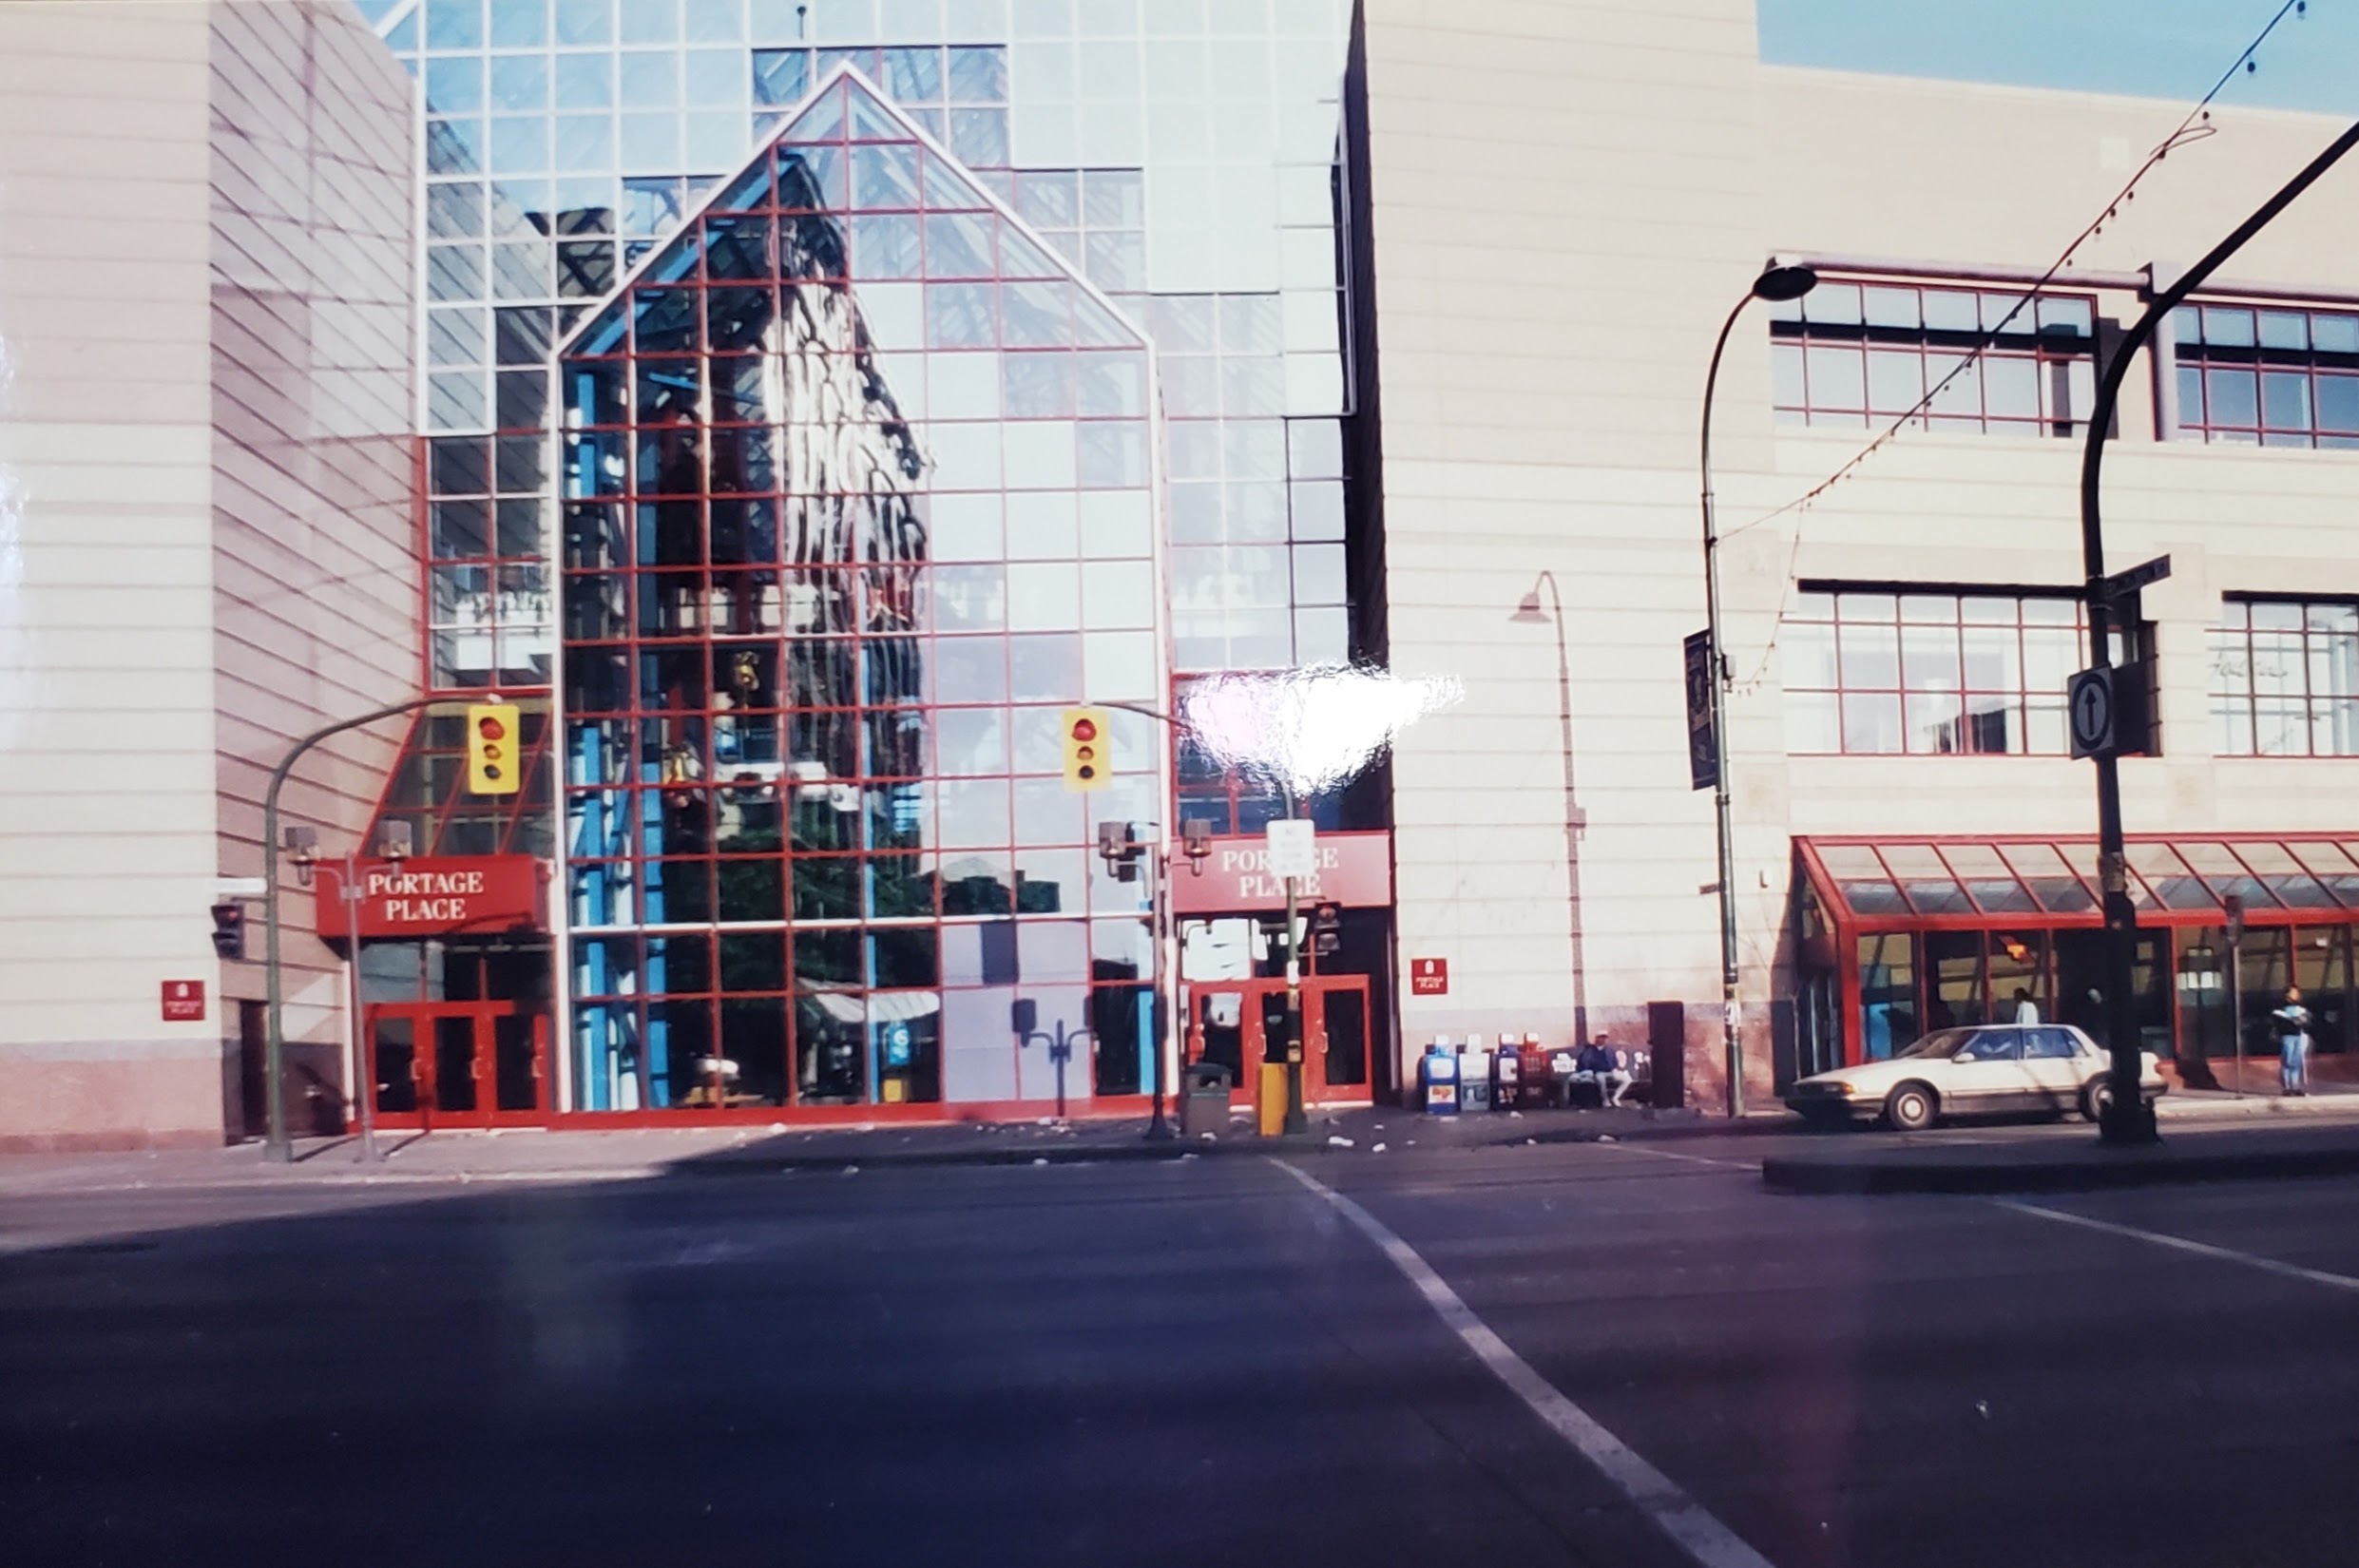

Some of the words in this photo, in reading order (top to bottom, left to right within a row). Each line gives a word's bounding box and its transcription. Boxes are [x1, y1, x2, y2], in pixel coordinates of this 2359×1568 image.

[1222, 848, 1339, 872] PORGE
[369, 871, 484, 895] PORTAGE
[386, 898, 468, 921] PLACE
